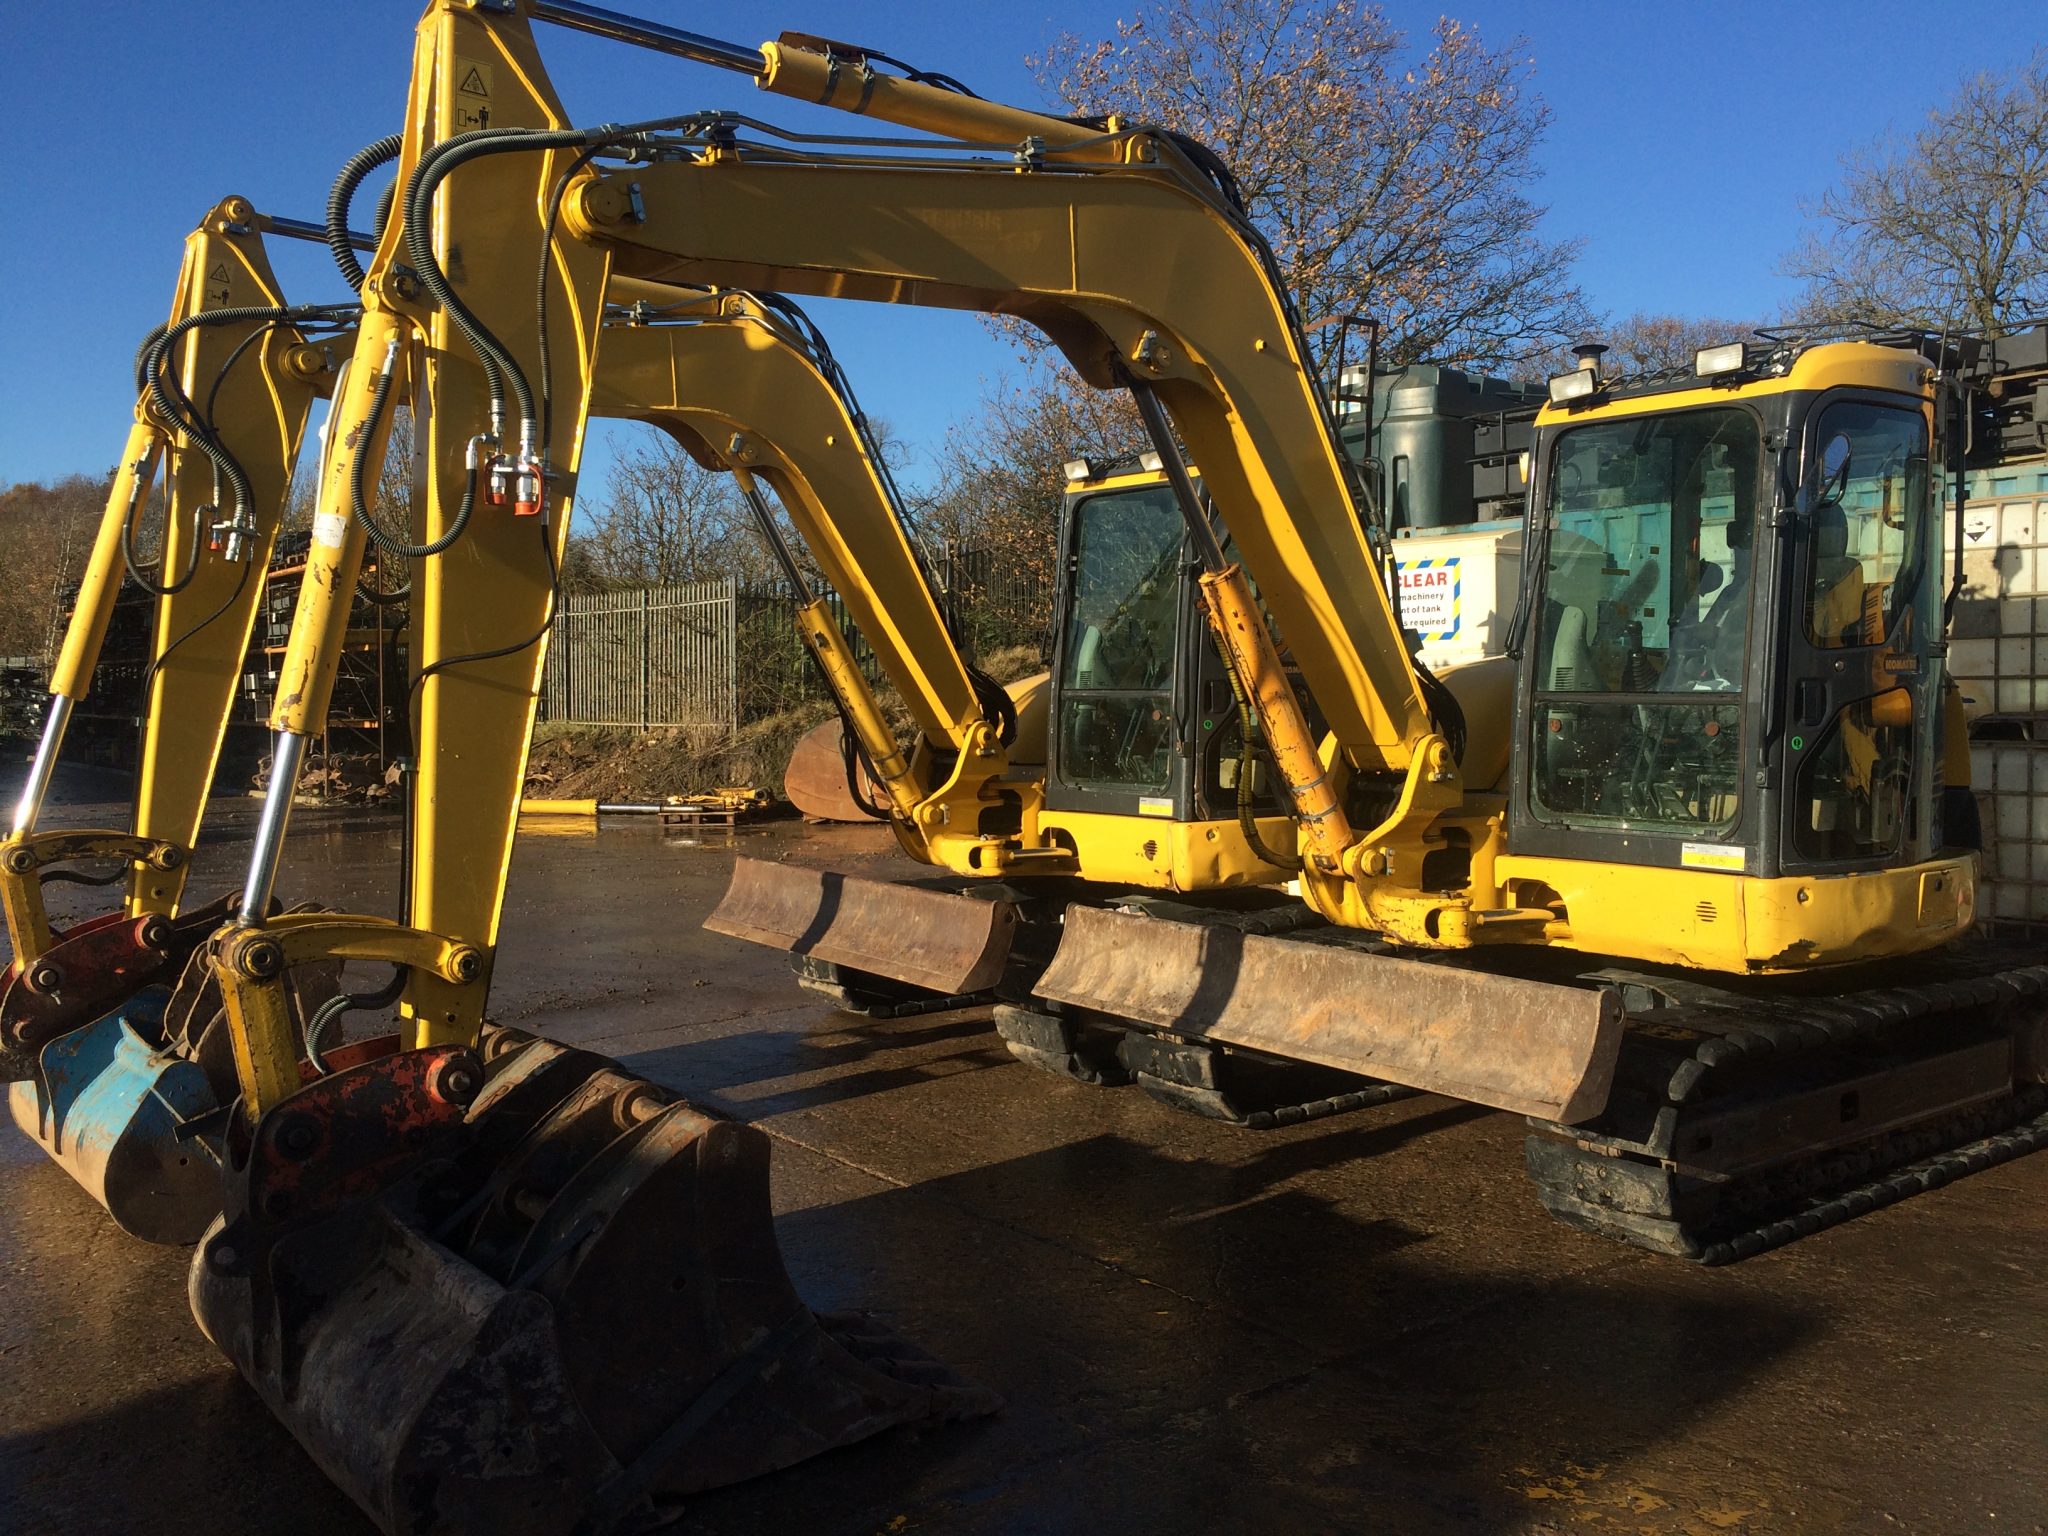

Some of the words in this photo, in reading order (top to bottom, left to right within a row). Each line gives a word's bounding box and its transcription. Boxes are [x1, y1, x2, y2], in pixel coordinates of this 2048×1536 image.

[1411, 605, 1420, 613] of
[1422, 604, 1441, 613] tank
[1409, 618, 1447, 627] required
